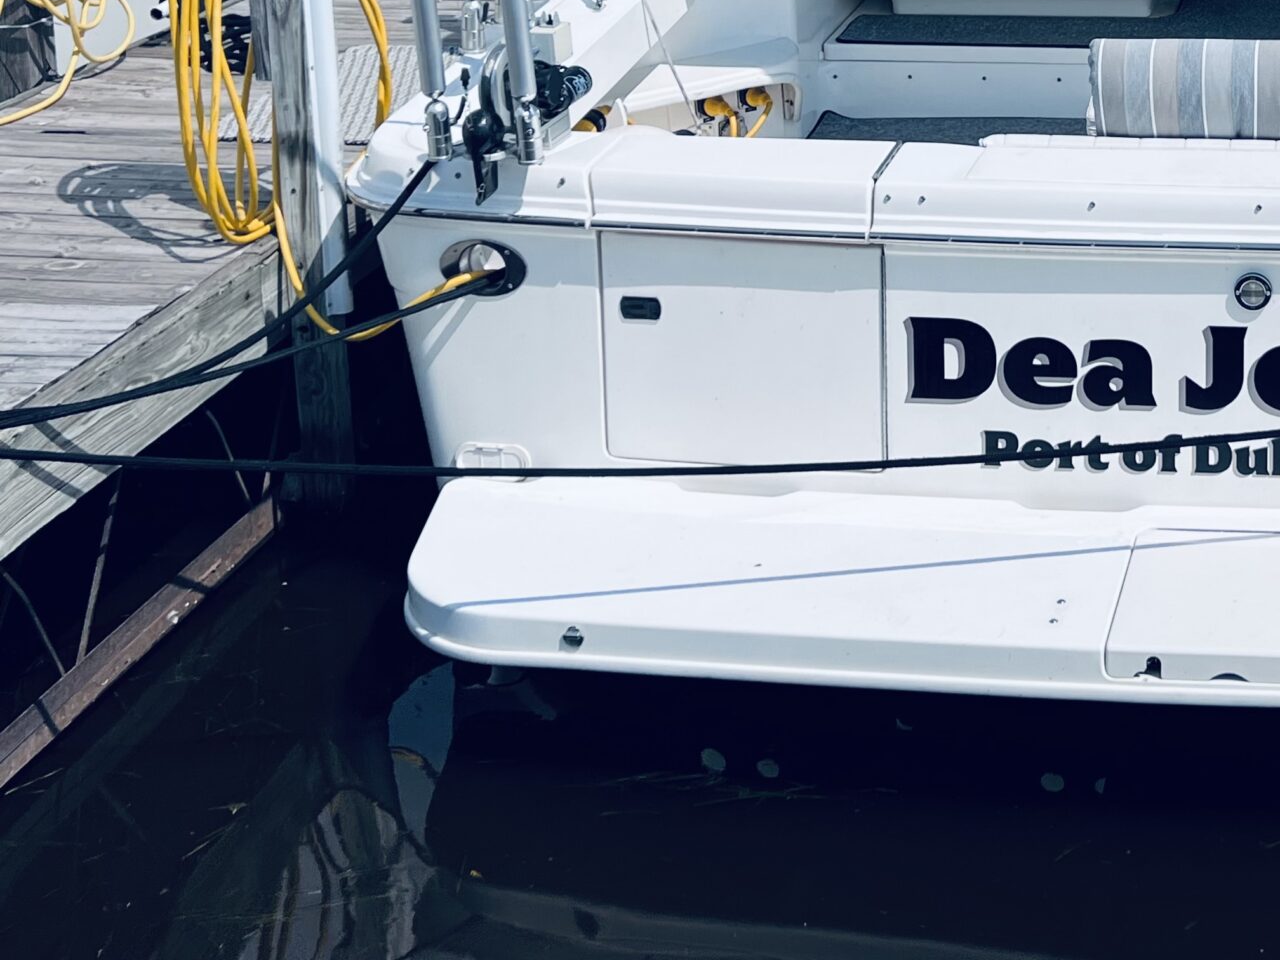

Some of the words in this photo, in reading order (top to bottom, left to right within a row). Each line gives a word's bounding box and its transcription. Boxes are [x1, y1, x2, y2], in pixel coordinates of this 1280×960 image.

[904, 316, 1158, 411] Dea
[980, 430, 1110, 473] Port
[1119, 434, 1183, 475] of
